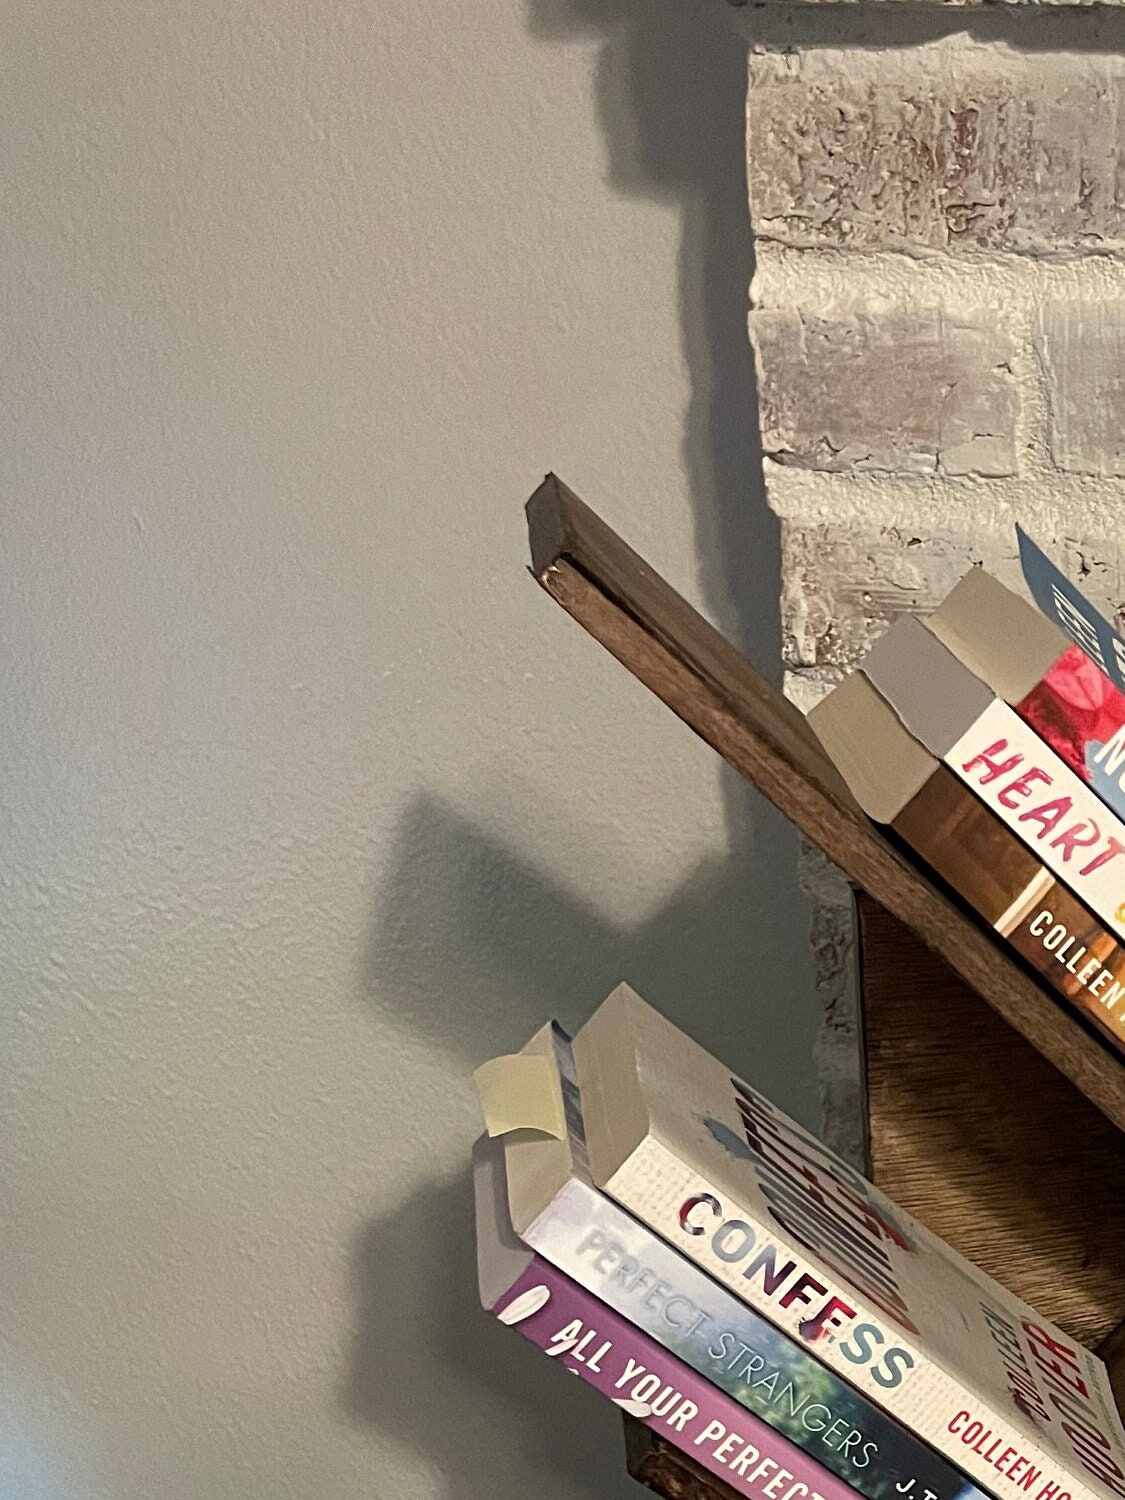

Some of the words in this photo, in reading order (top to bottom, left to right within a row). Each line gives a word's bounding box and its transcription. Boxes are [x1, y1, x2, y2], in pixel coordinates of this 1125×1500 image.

[575, 1224, 708, 1349] PERFECT
[708, 1332, 879, 1470] STRANGERS
[679, 1192, 916, 1390] CONFESS
[547, 1318, 603, 1374] ALL
[614, 1357, 700, 1432] YOUR
[947, 1409, 1042, 1493] COLLEEN
